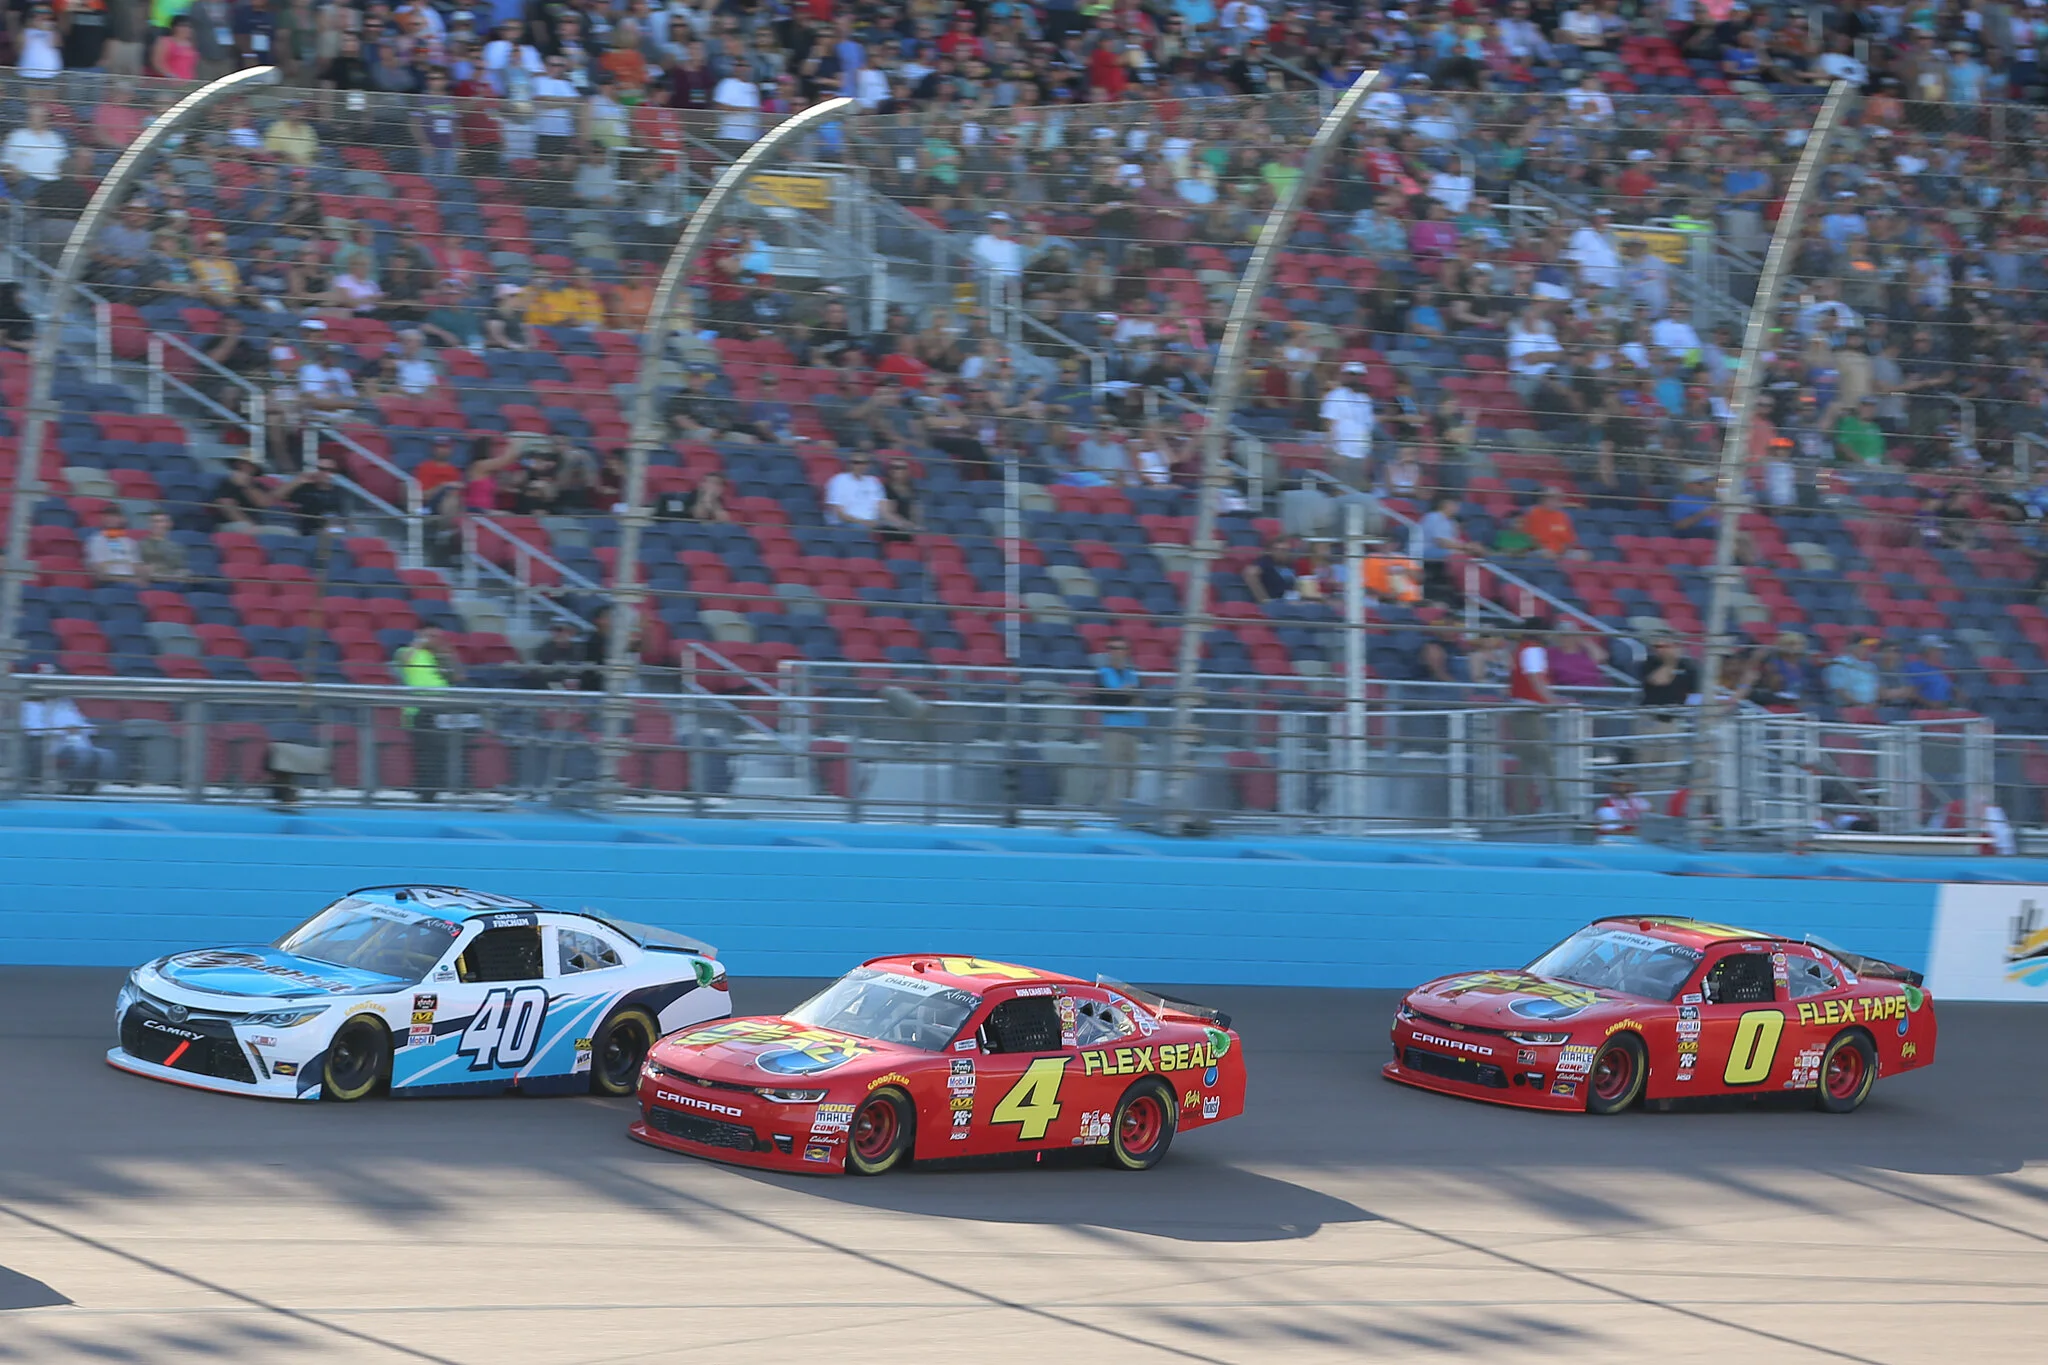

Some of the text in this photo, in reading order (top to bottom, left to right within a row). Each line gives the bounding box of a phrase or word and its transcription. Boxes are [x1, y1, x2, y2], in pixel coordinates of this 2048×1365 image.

[1668, 945, 1703, 960] xfinity
[884, 977, 930, 992] CHASTAIN
[944, 989, 982, 1011] xfinity
[1796, 995, 1906, 1027] FLEX TAPE
[143, 1019, 205, 1041] CAMRY
[457, 985, 550, 1073] 40
[1605, 1018, 1643, 1036] GOODYEAR
[1411, 1031, 1494, 1056] CAMARO
[1564, 1045, 1598, 1054] MOOG
[1723, 1009, 1786, 1087] 0
[1081, 1041, 1217, 1077] FLEX SEAL
[1559, 1053, 1592, 1063] MAHLE
[1559, 1063, 1583, 1072] COMP
[866, 1071, 911, 1091] GOODYEAR
[656, 1089, 743, 1118] CAMARO
[818, 1103, 856, 1113] MOOG
[989, 1055, 1075, 1141] 4
[813, 1123, 840, 1133] COMP
